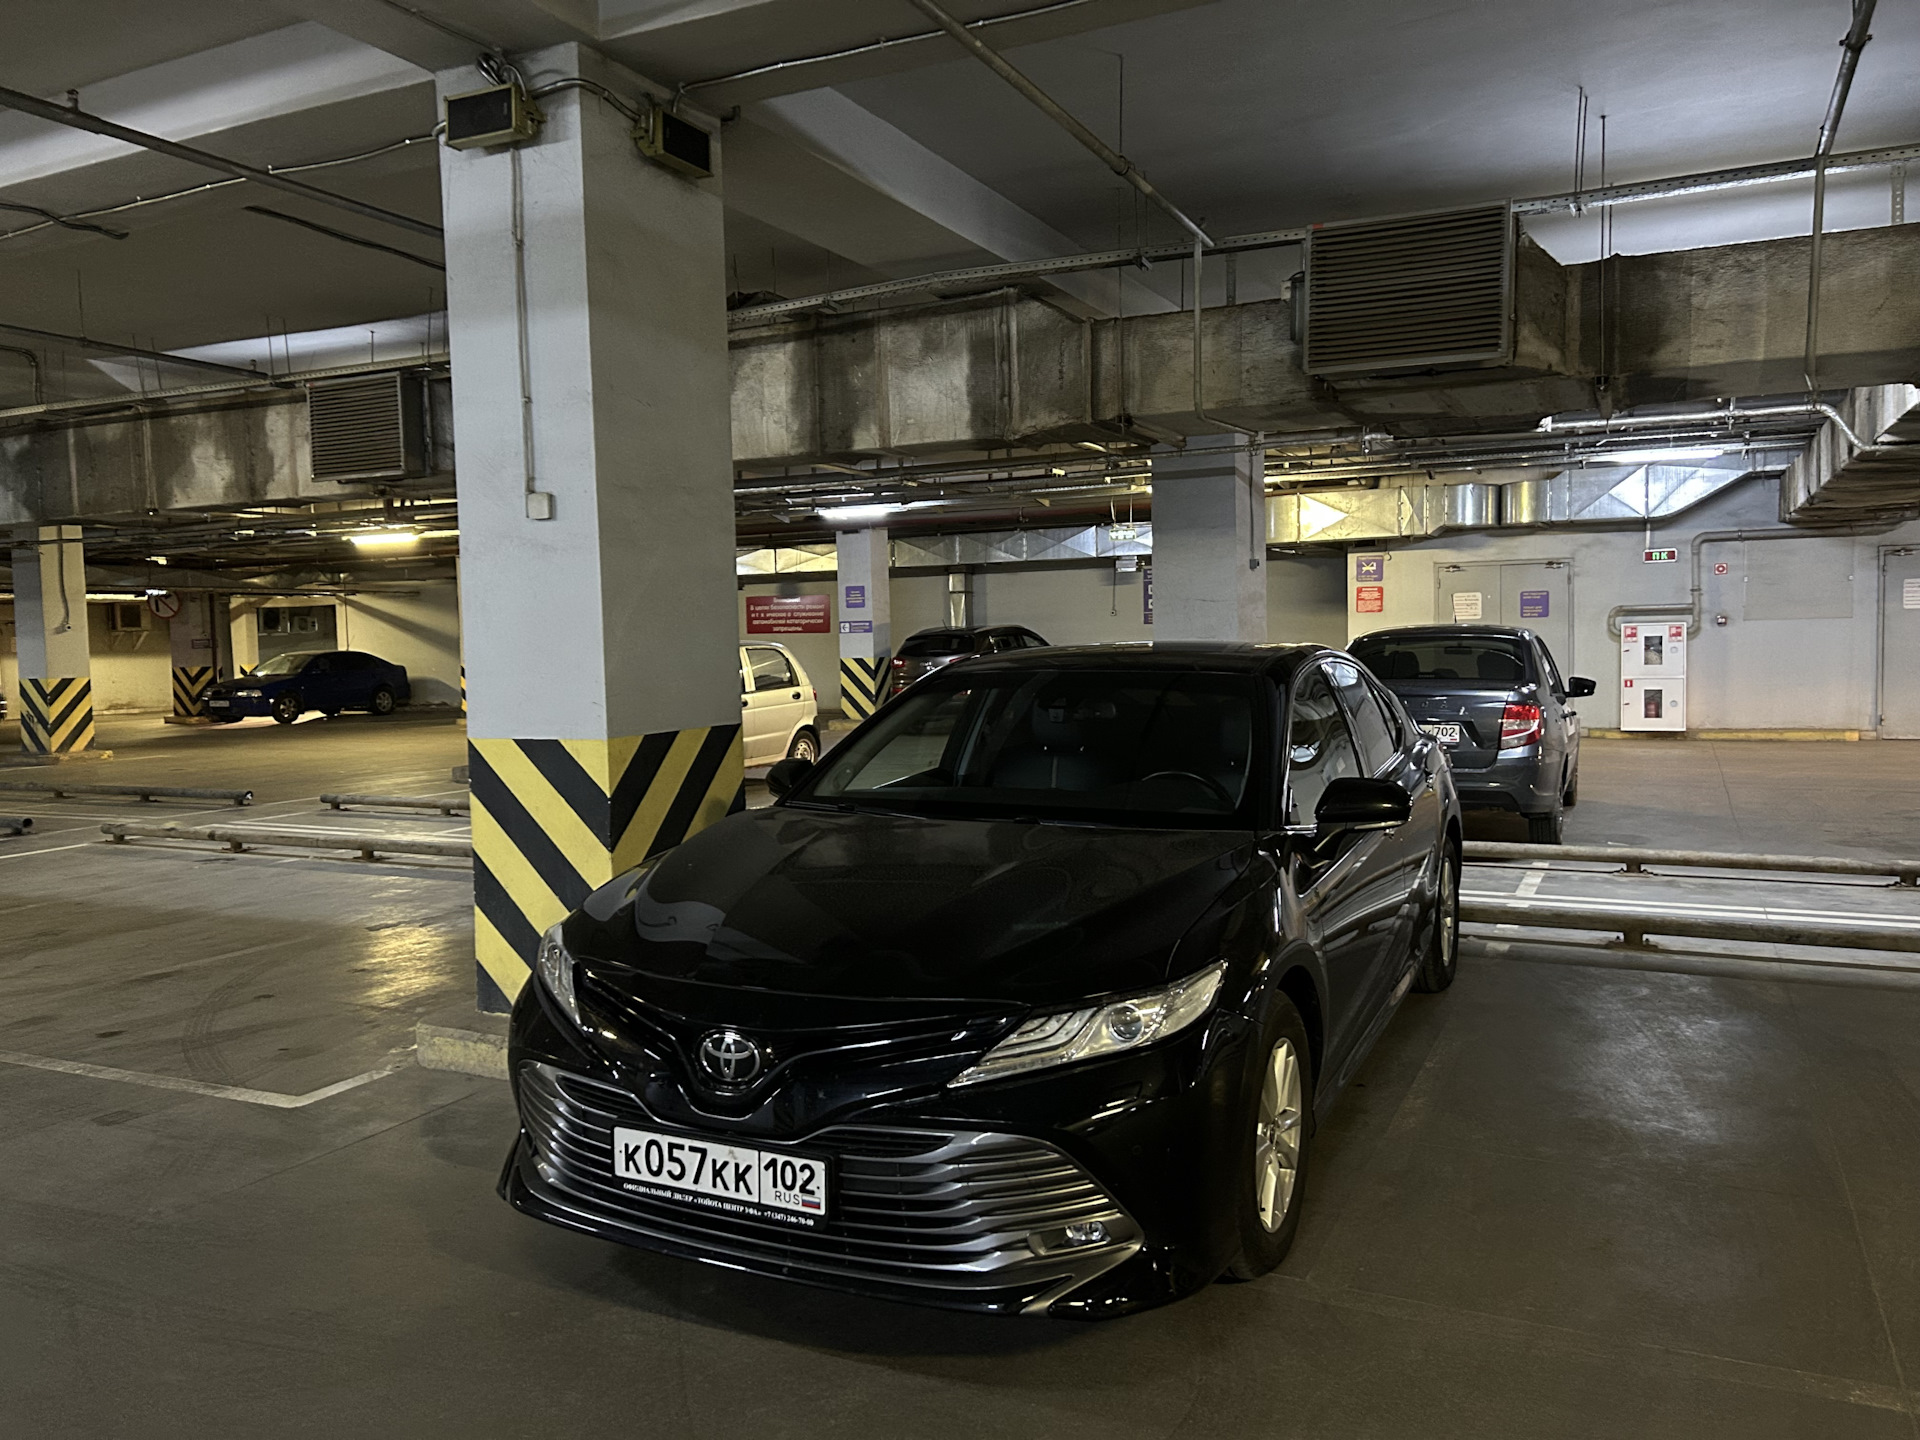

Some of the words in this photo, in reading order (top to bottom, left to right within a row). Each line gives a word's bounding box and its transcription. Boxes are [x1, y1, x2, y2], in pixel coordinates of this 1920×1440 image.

[1652, 551, 1668, 560] ПК
[1434, 726, 1456, 737] 702
[763, 1157, 815, 1195] 102
[774, 1190, 800, 1205] RUS
[723, 1202, 744, 1212] ЦЕНТР
